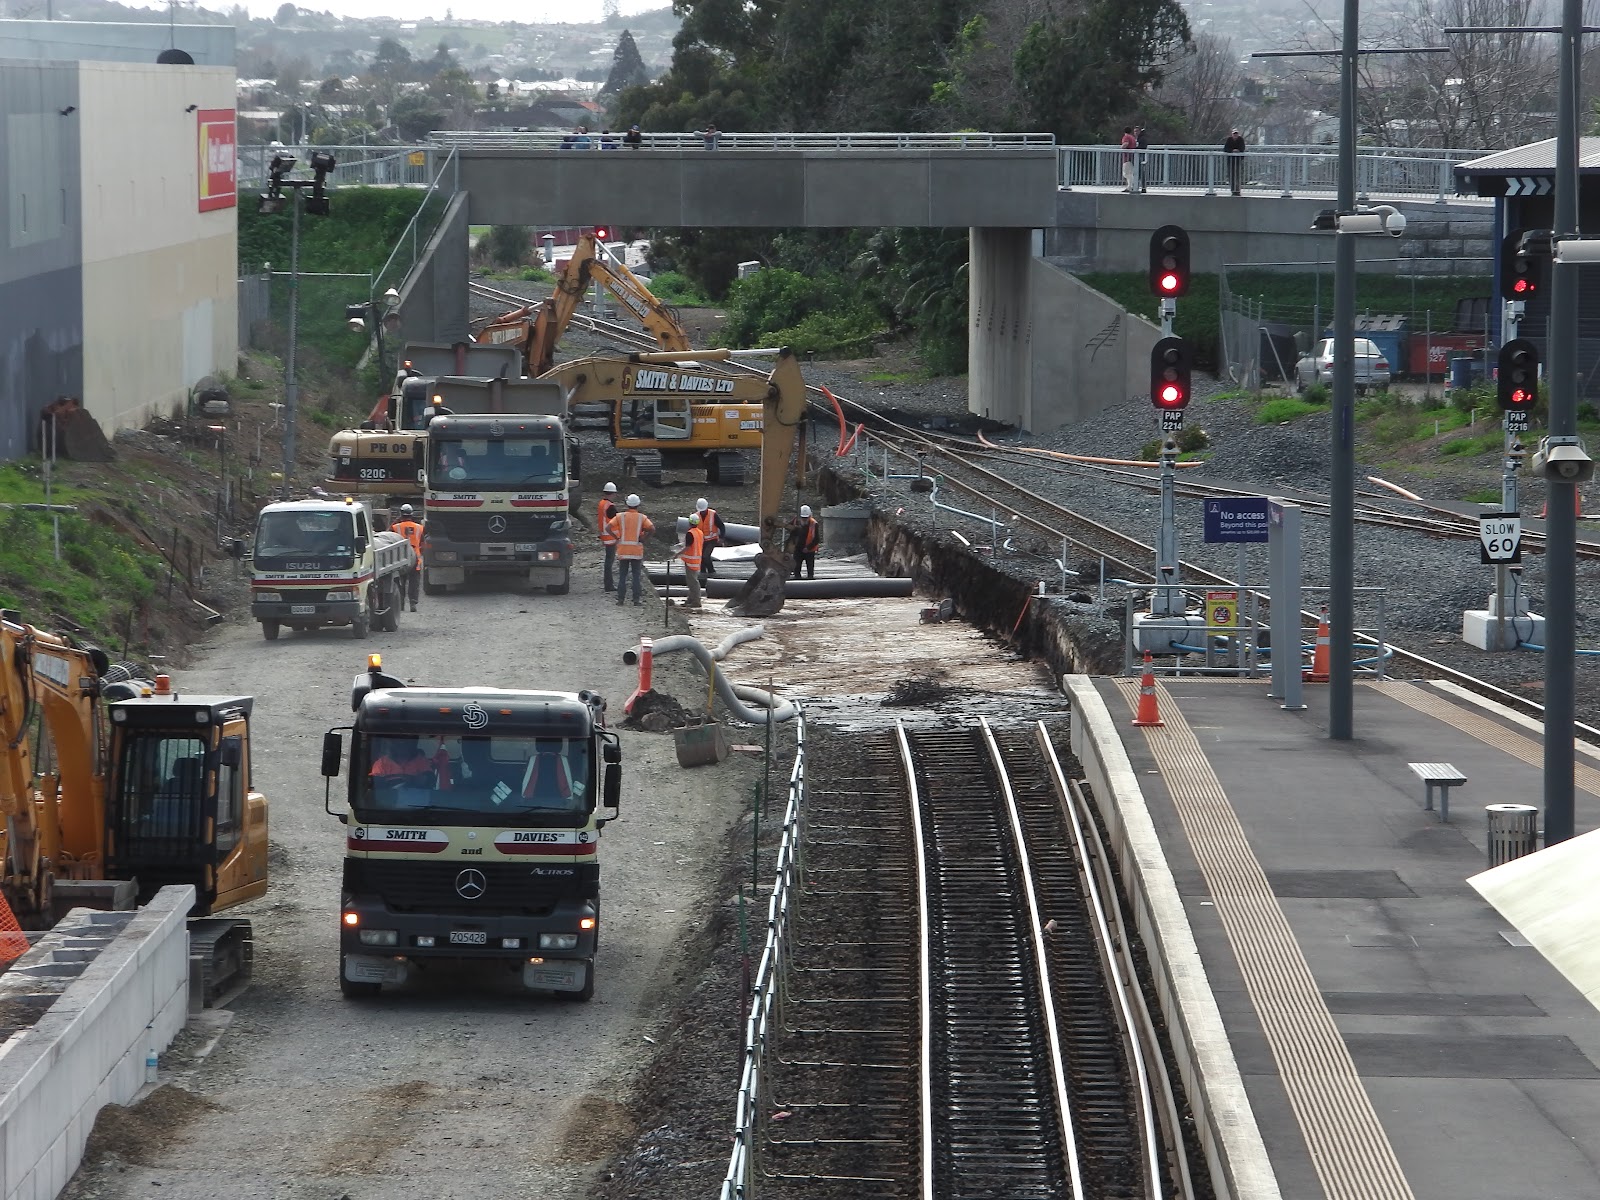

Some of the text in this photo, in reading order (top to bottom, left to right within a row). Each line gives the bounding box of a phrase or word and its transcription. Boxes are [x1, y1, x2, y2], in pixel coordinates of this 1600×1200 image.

[635, 369, 734, 393] SMITH & DAVIES LTD
[1165, 411, 1181, 420] PAP
[1510, 413, 1526, 421] PAP
[1163, 421, 1182, 430] 2214
[1509, 422, 1528, 431] 2216
[370, 443, 407, 453] PH 09
[360, 468, 386, 479] 320C
[1220, 511, 1234, 520] No
[1236, 512, 1265, 520] access
[1485, 523, 1515, 535] SLOW
[1488, 538, 1514, 552] 60
[285, 562, 321, 570] ISUZU
[386, 829, 428, 840] SMITH
[460, 847, 483, 855] and
[513, 832, 558, 842] DAVIES
